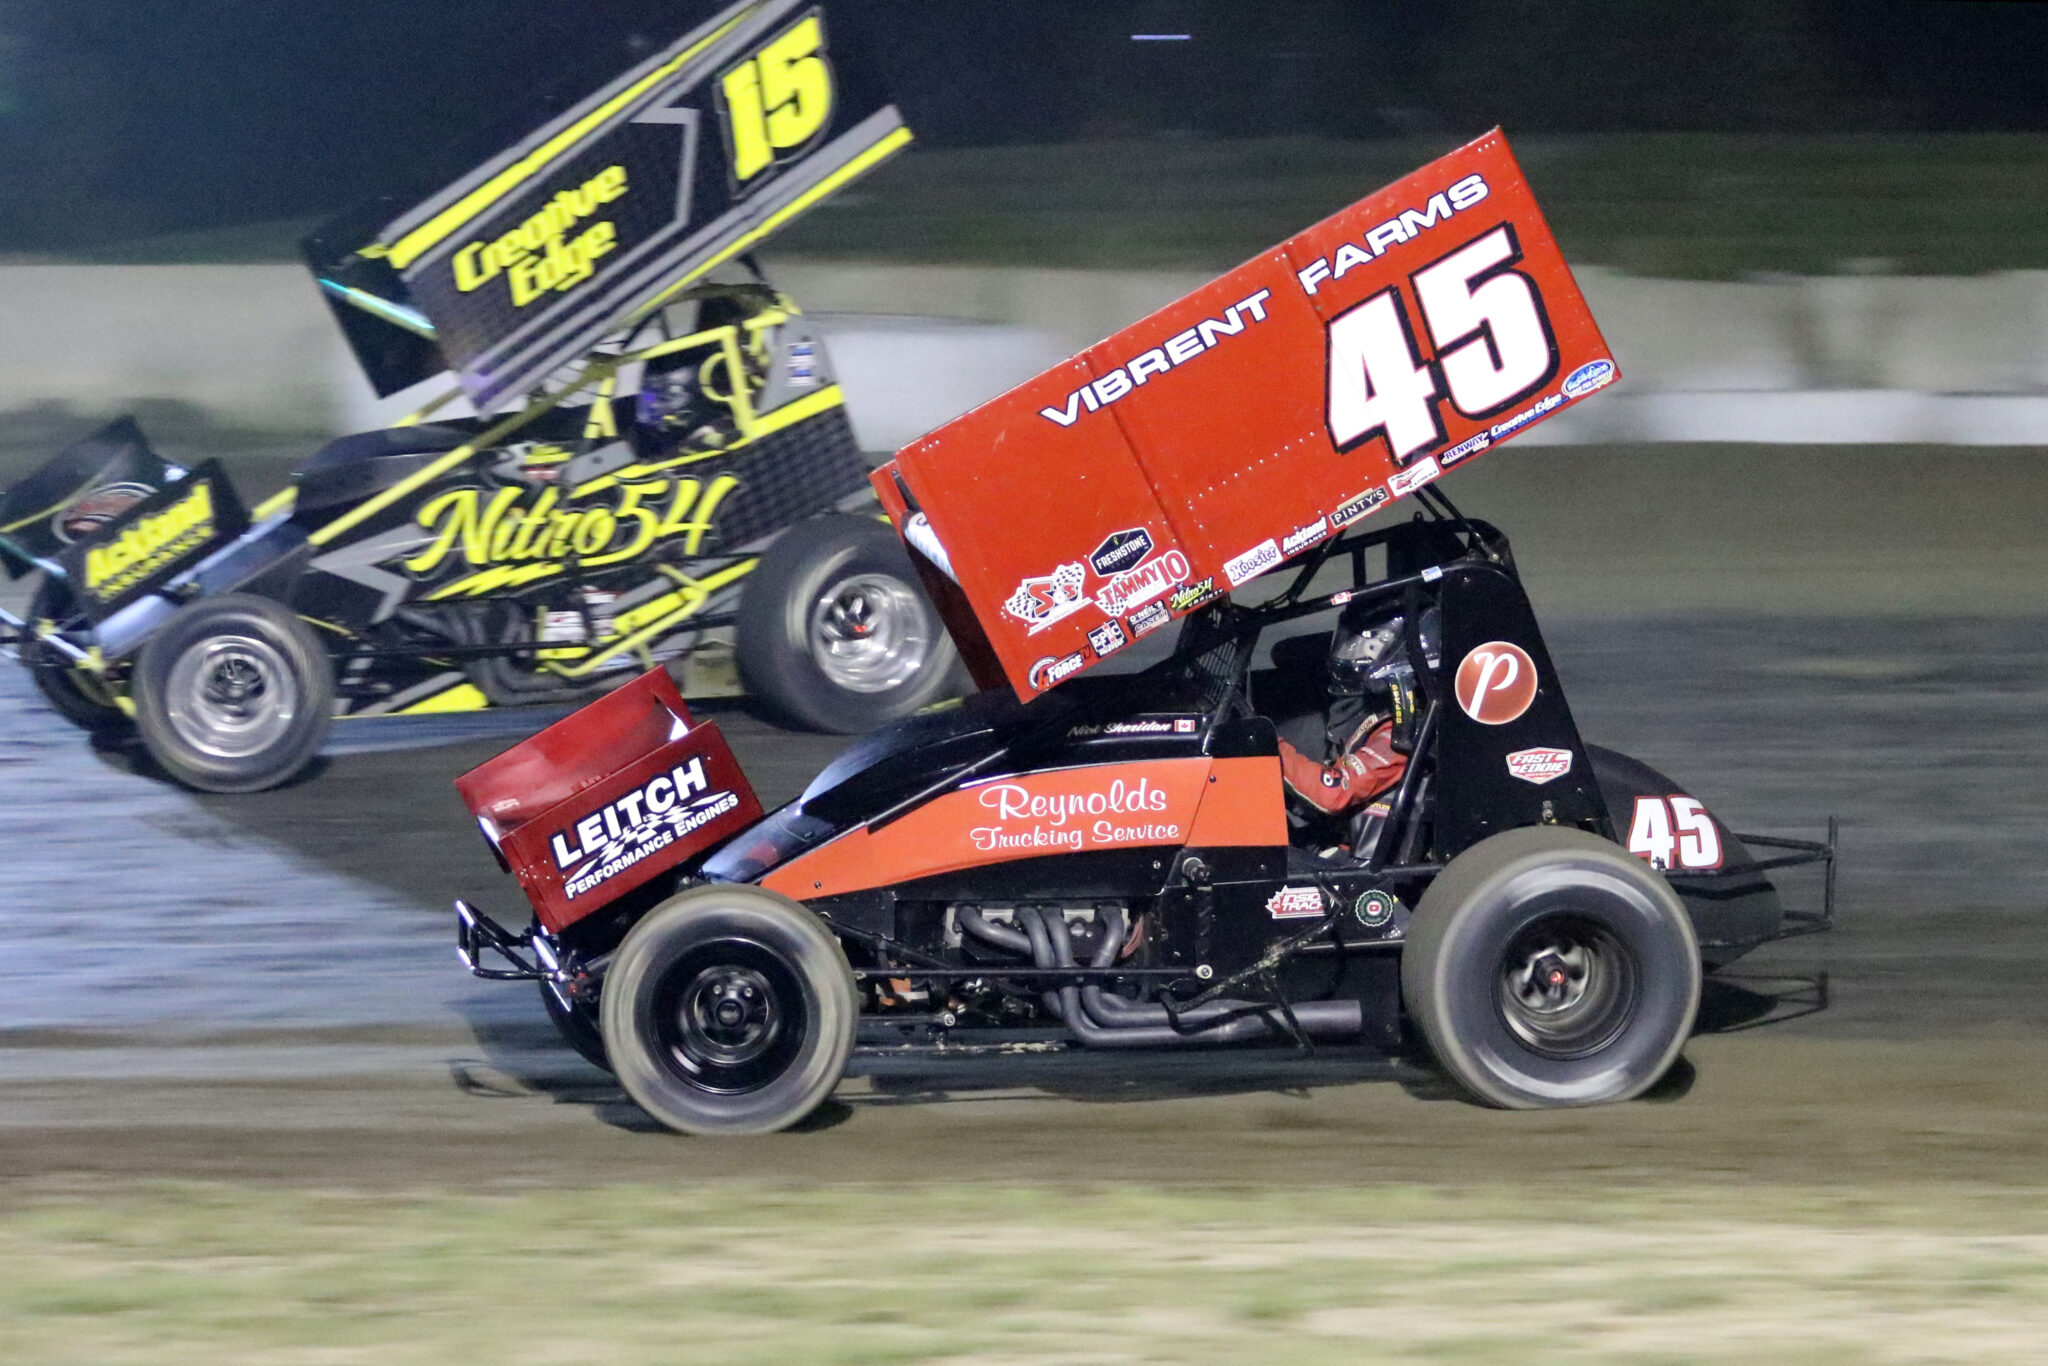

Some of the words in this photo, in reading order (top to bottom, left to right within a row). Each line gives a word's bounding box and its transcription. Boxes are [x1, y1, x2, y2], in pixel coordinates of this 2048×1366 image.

[722, 16, 832, 180] 15
[452, 165, 629, 291] Creative
[507, 221, 617, 307] Edge
[1039, 288, 1271, 427] VIBRENT
[1297, 173, 1490, 295] FARMS
[1326, 223, 1556, 465] 45
[1490, 406, 1535, 437] Creative
[1534, 393, 1562, 414] Edge
[1445, 435, 1483, 460] RENWAY
[406, 475, 740, 571] Nitro54
[1334, 490, 1385, 523] PINTY'S
[1096, 534, 1148, 570] FRESHSTONE
[1283, 516, 1327, 552] Ackland
[1287, 531, 1328, 555] INSURANCE
[1231, 546, 1277, 582] Hoosier
[1129, 600, 1164, 624] O'NEIL'S
[1091, 626, 1122, 648] EPIC
[1512, 752, 1557, 763] FAST
[1518, 762, 1568, 774] EDDIE
[552, 756, 708, 869] LEITCH
[979, 777, 1167, 826] Reynolds
[563, 831, 674, 900] PERFORMANCE
[674, 793, 739, 843] ENGINES
[970, 825, 1083, 850] Trucking
[1092, 820, 1180, 843] Service
[1628, 794, 1722, 869] 45
[1281, 902, 1323, 912] TRAC
[1283, 892, 1320, 902] INSID
